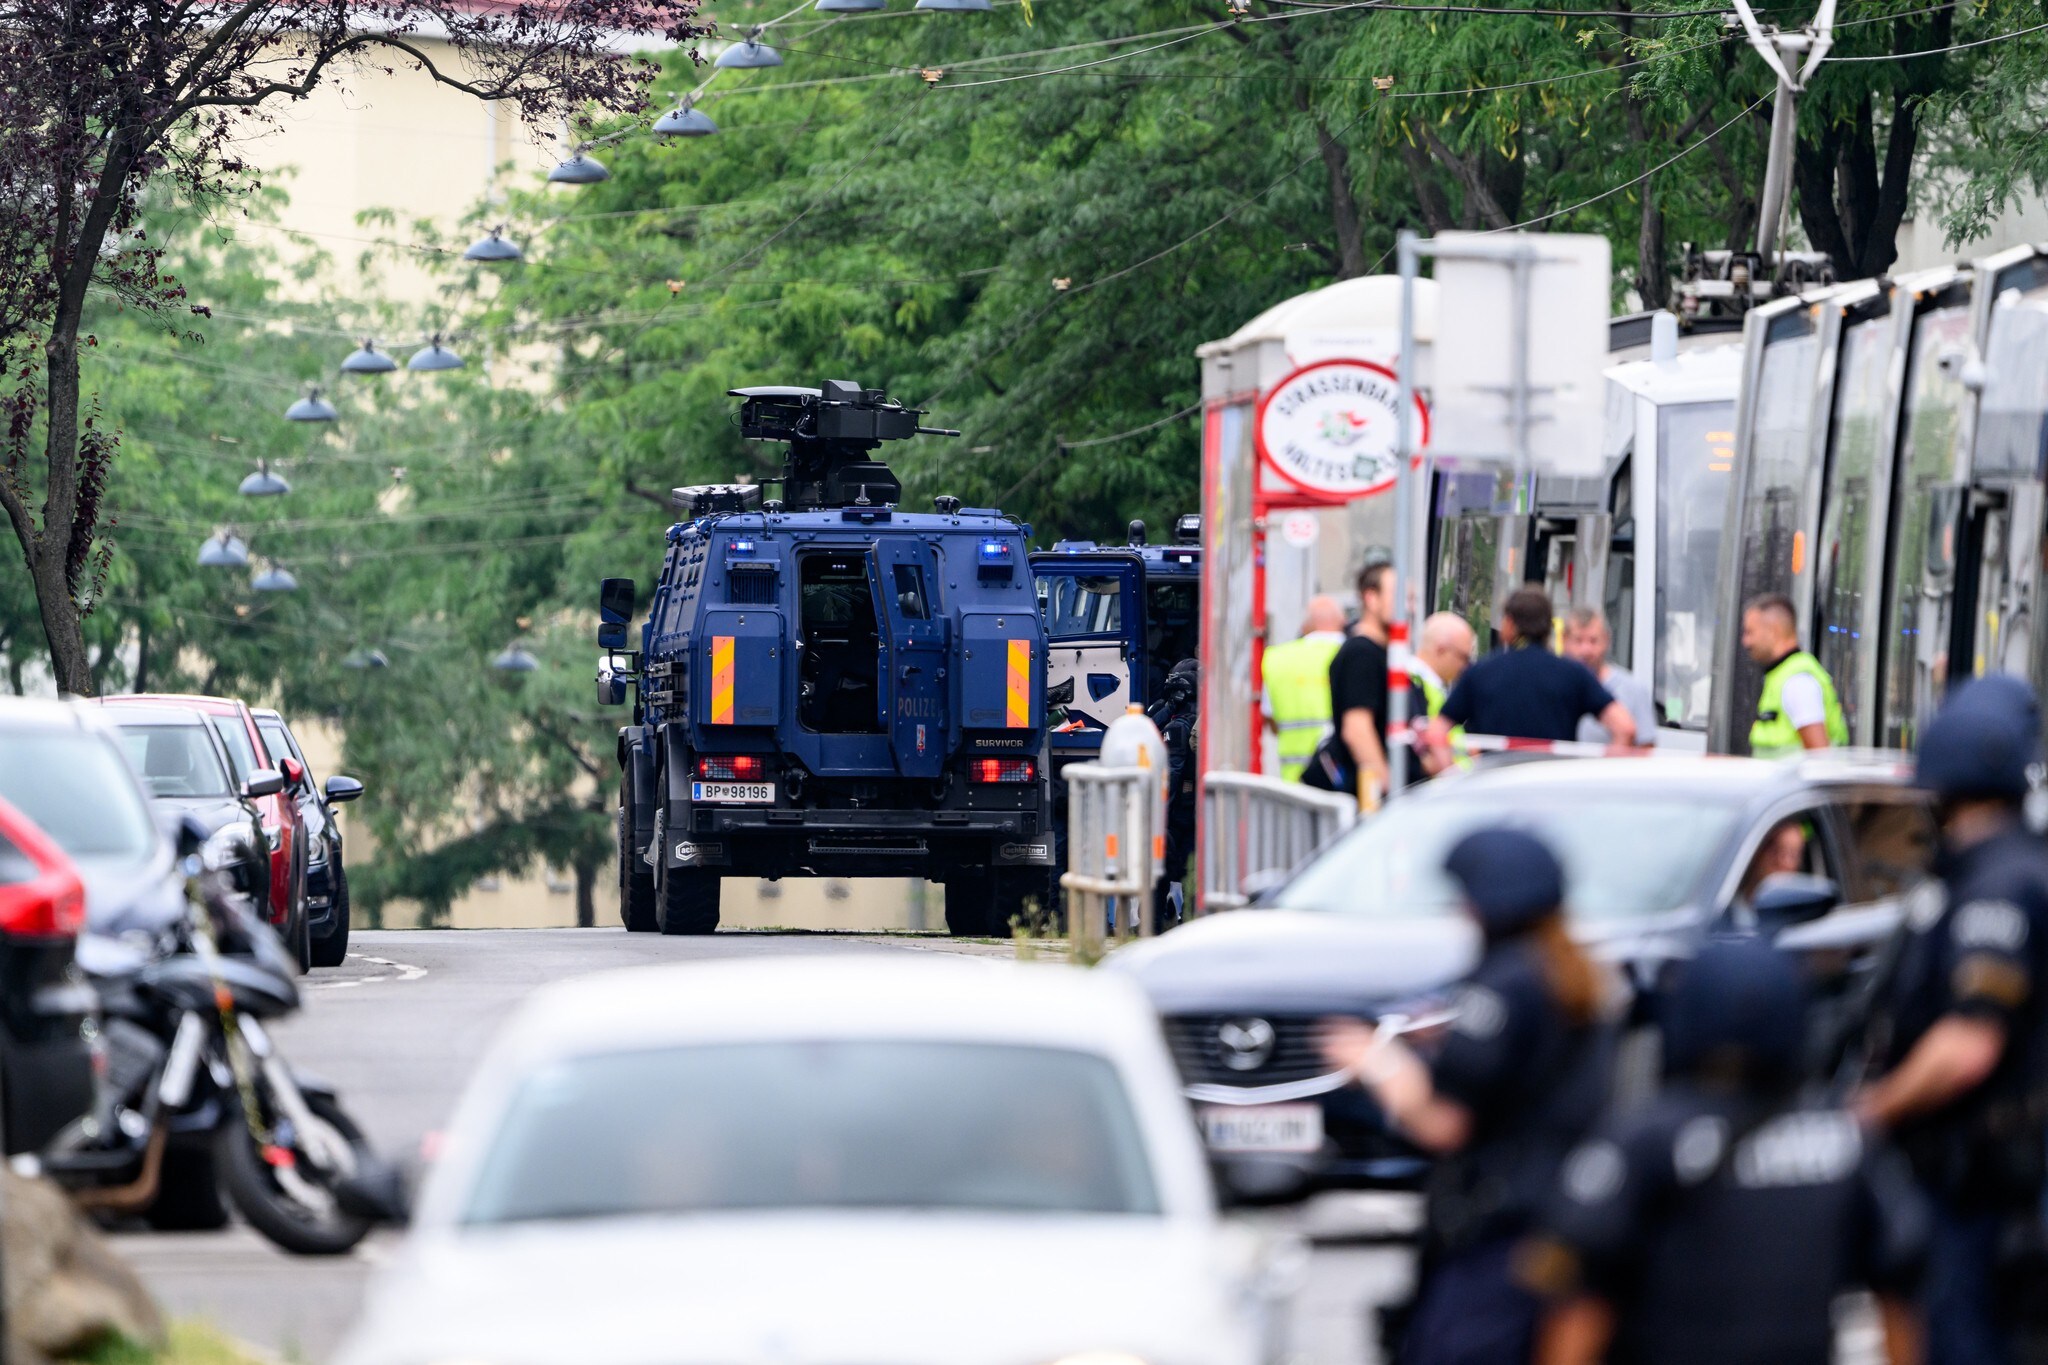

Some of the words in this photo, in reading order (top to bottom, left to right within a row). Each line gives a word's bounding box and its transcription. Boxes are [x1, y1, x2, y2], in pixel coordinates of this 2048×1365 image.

[1276, 373, 1400, 418] STRASSENBAH
[975, 739, 1024, 747] SURVIVOR
[706, 786, 721, 798] BP
[731, 786, 768, 798] 98196
